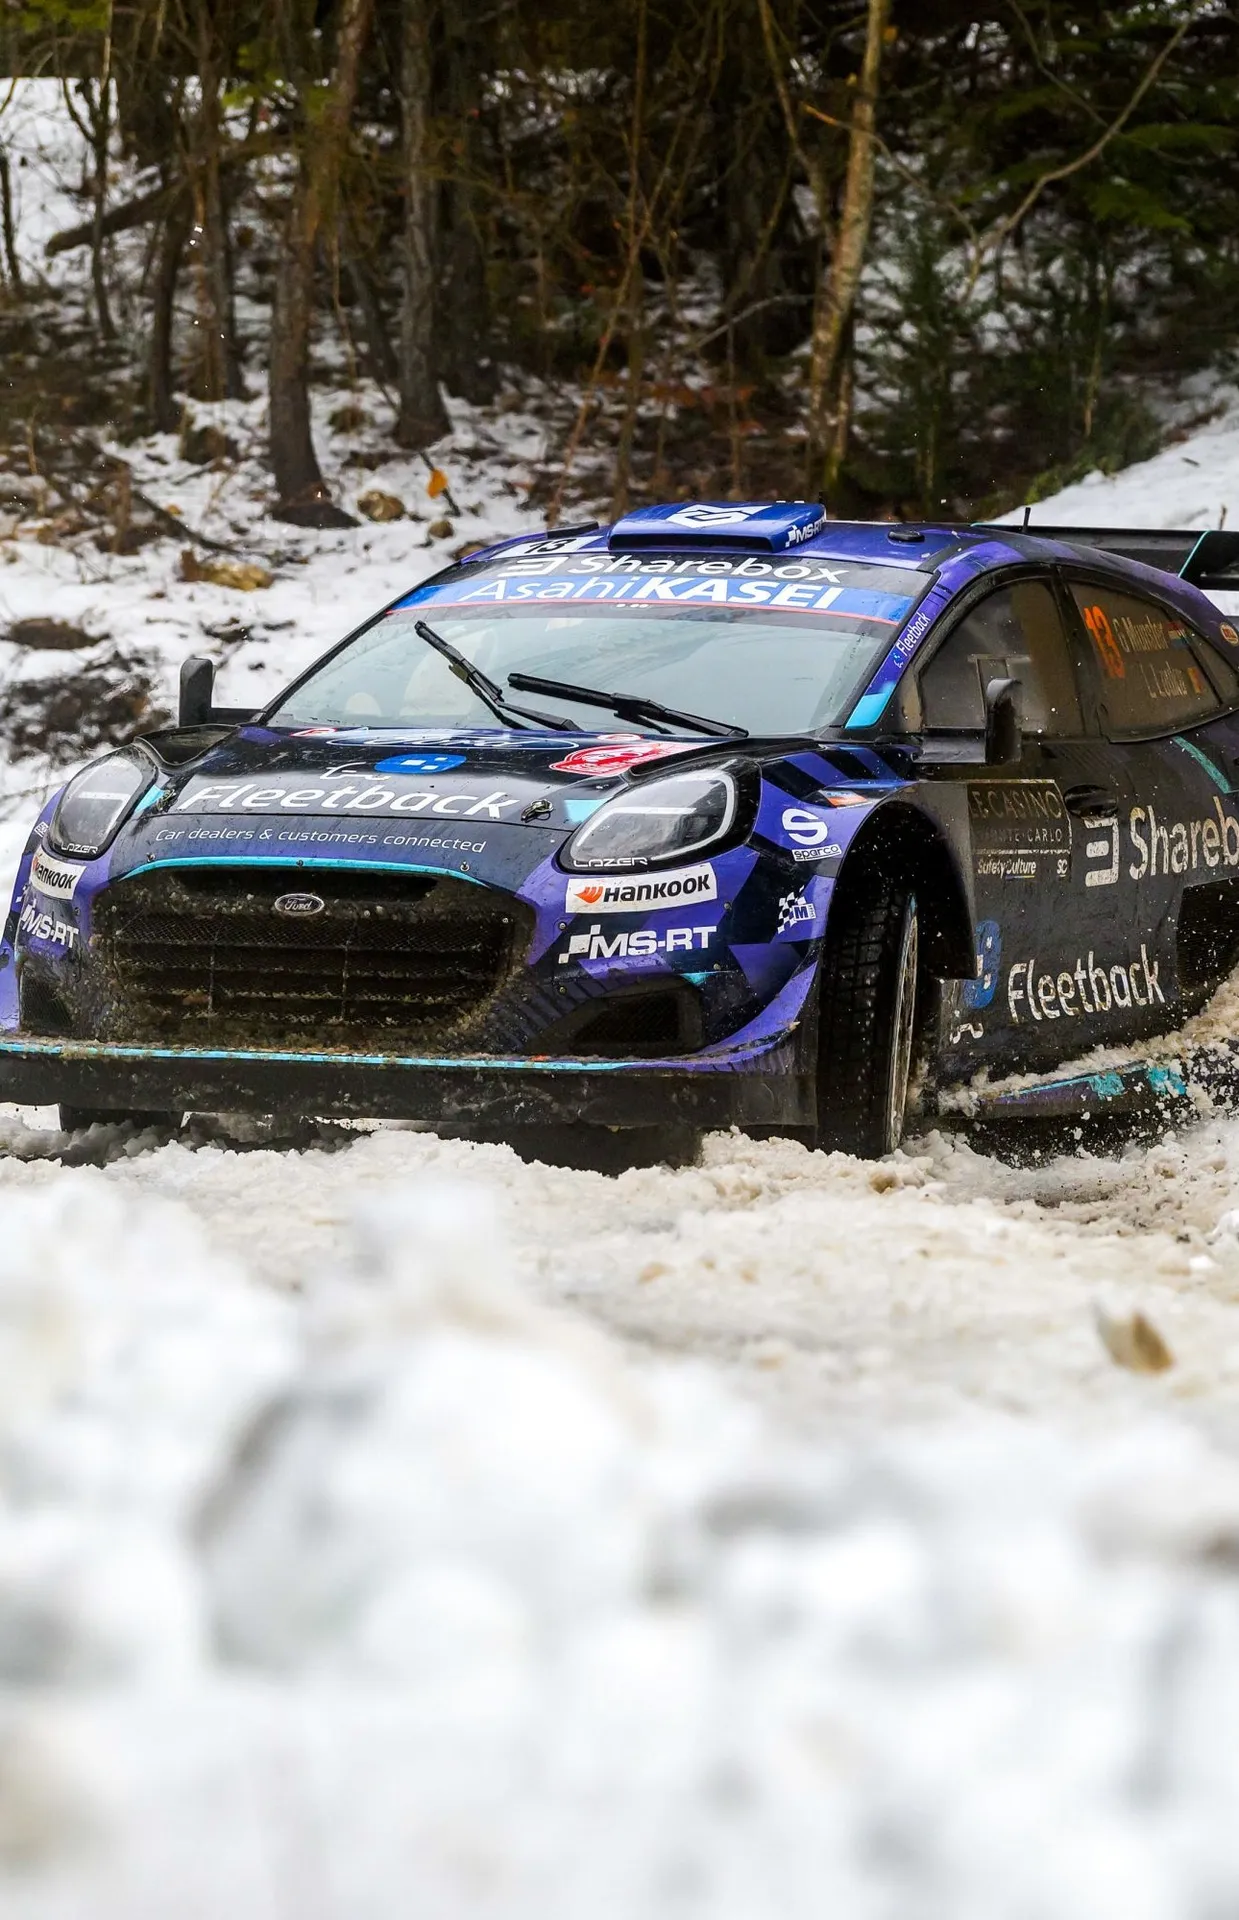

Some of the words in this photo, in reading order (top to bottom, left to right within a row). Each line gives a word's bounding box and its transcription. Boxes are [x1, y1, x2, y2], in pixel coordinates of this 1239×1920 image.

[525, 538, 577, 554] 13
[567, 555, 851, 583] Sharebox
[895, 611, 931, 657] Fleetback
[1084, 606, 1126, 679] 13
[177, 784, 520, 819] Fleetback
[988, 788, 1062, 819] CASINO
[156, 829, 185, 841] Car
[188, 828, 253, 840] dealers
[258, 828, 271, 840] &
[278, 831, 378, 844] customers
[383, 834, 486, 854] connected
[1129, 795, 1239, 881] Shareb
[284, 898, 313, 911] Ford
[22, 904, 79, 949] MS-RT
[589, 925, 717, 960] MS-RT
[1008, 943, 1166, 1023] Fleetback
